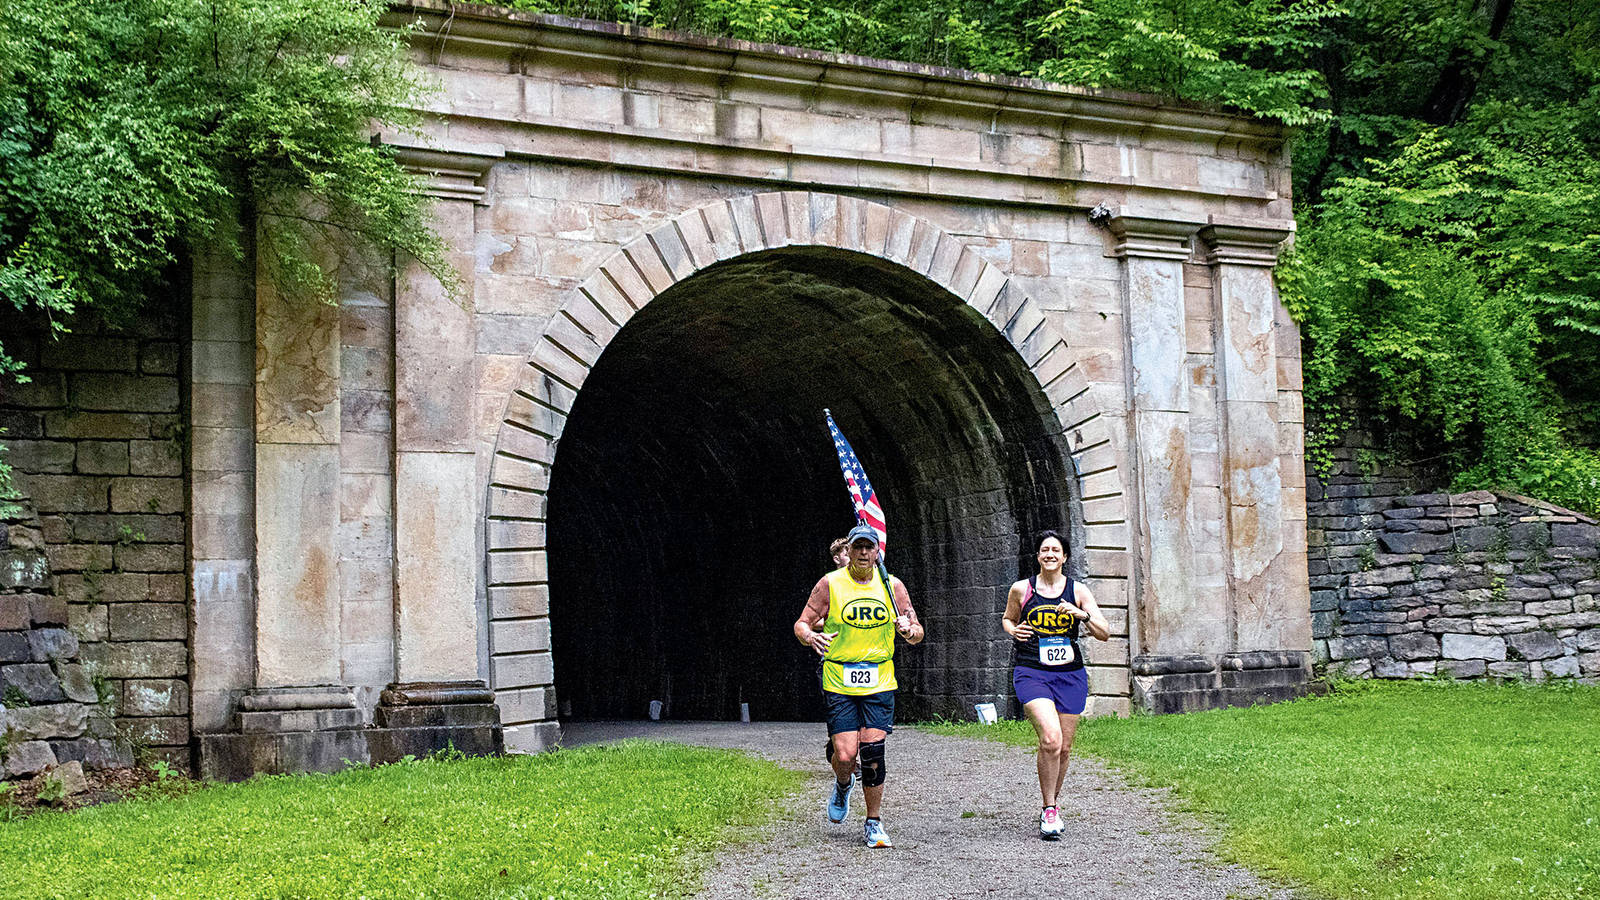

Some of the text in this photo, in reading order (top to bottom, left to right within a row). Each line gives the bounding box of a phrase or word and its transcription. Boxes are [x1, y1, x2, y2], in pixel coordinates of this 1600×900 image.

[847, 606, 886, 621] JRC
[1031, 612, 1070, 626] JRC
[1047, 648, 1067, 661] 622
[850, 670, 871, 684] 623
